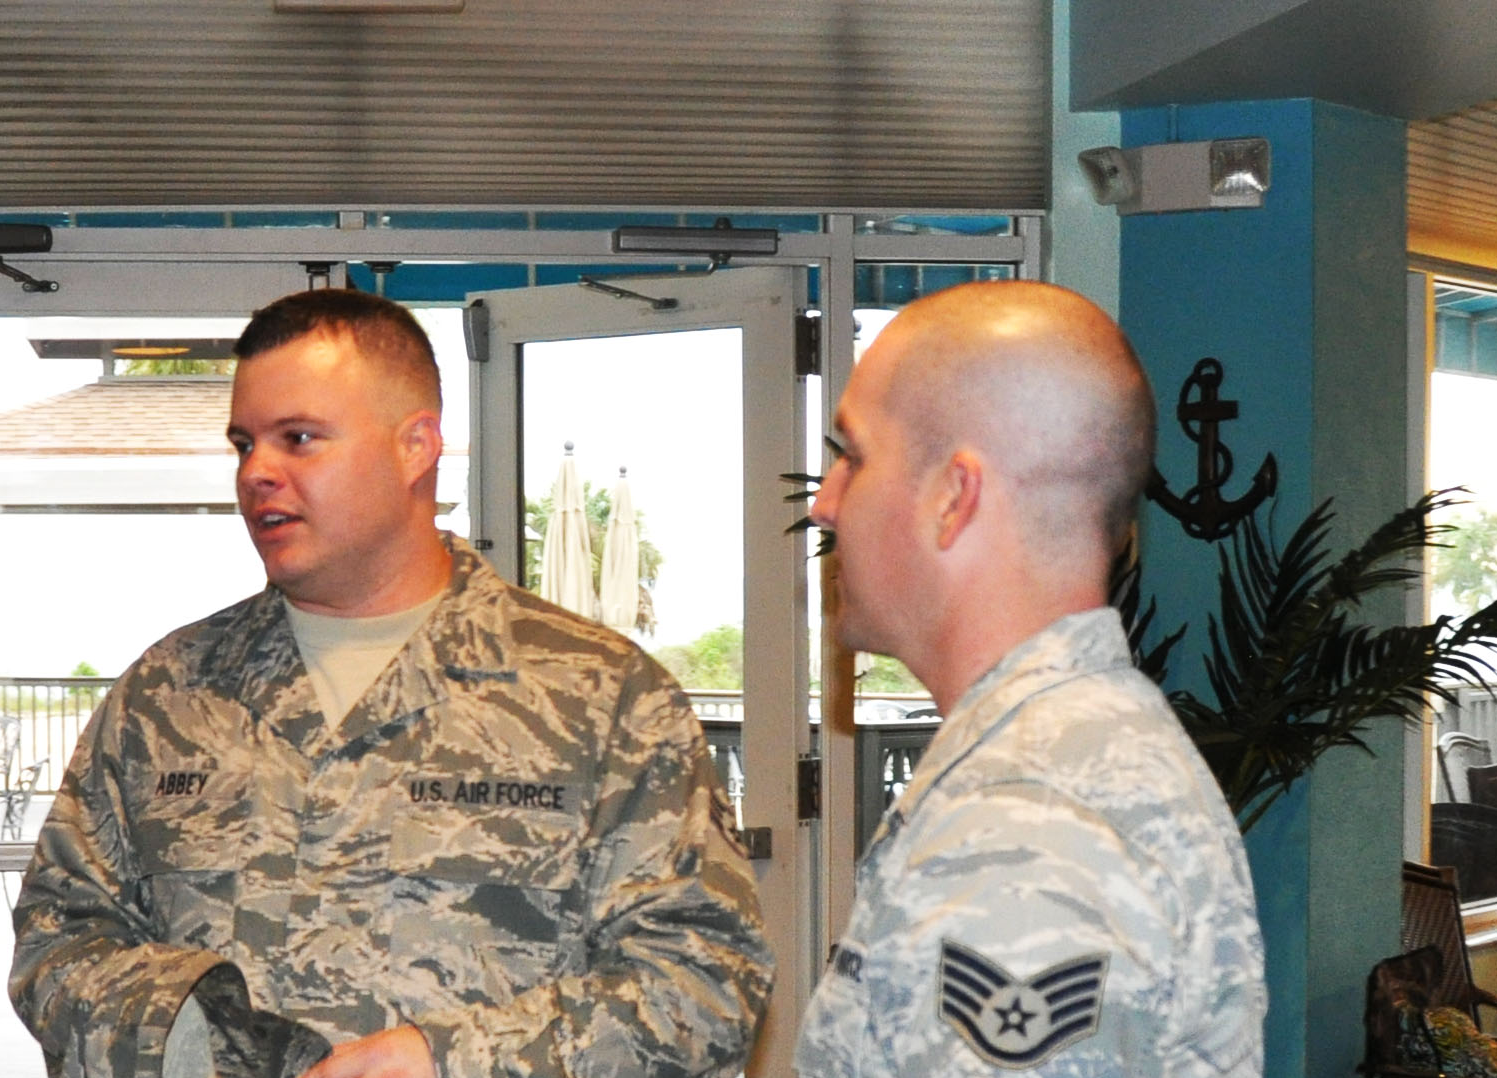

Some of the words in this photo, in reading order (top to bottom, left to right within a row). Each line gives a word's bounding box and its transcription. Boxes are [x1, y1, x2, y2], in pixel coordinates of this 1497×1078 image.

[155, 772, 209, 796] ABBEY
[410, 780, 448, 803] U.S.
[454, 780, 490, 804] AIR
[495, 781, 566, 810] FORCE
